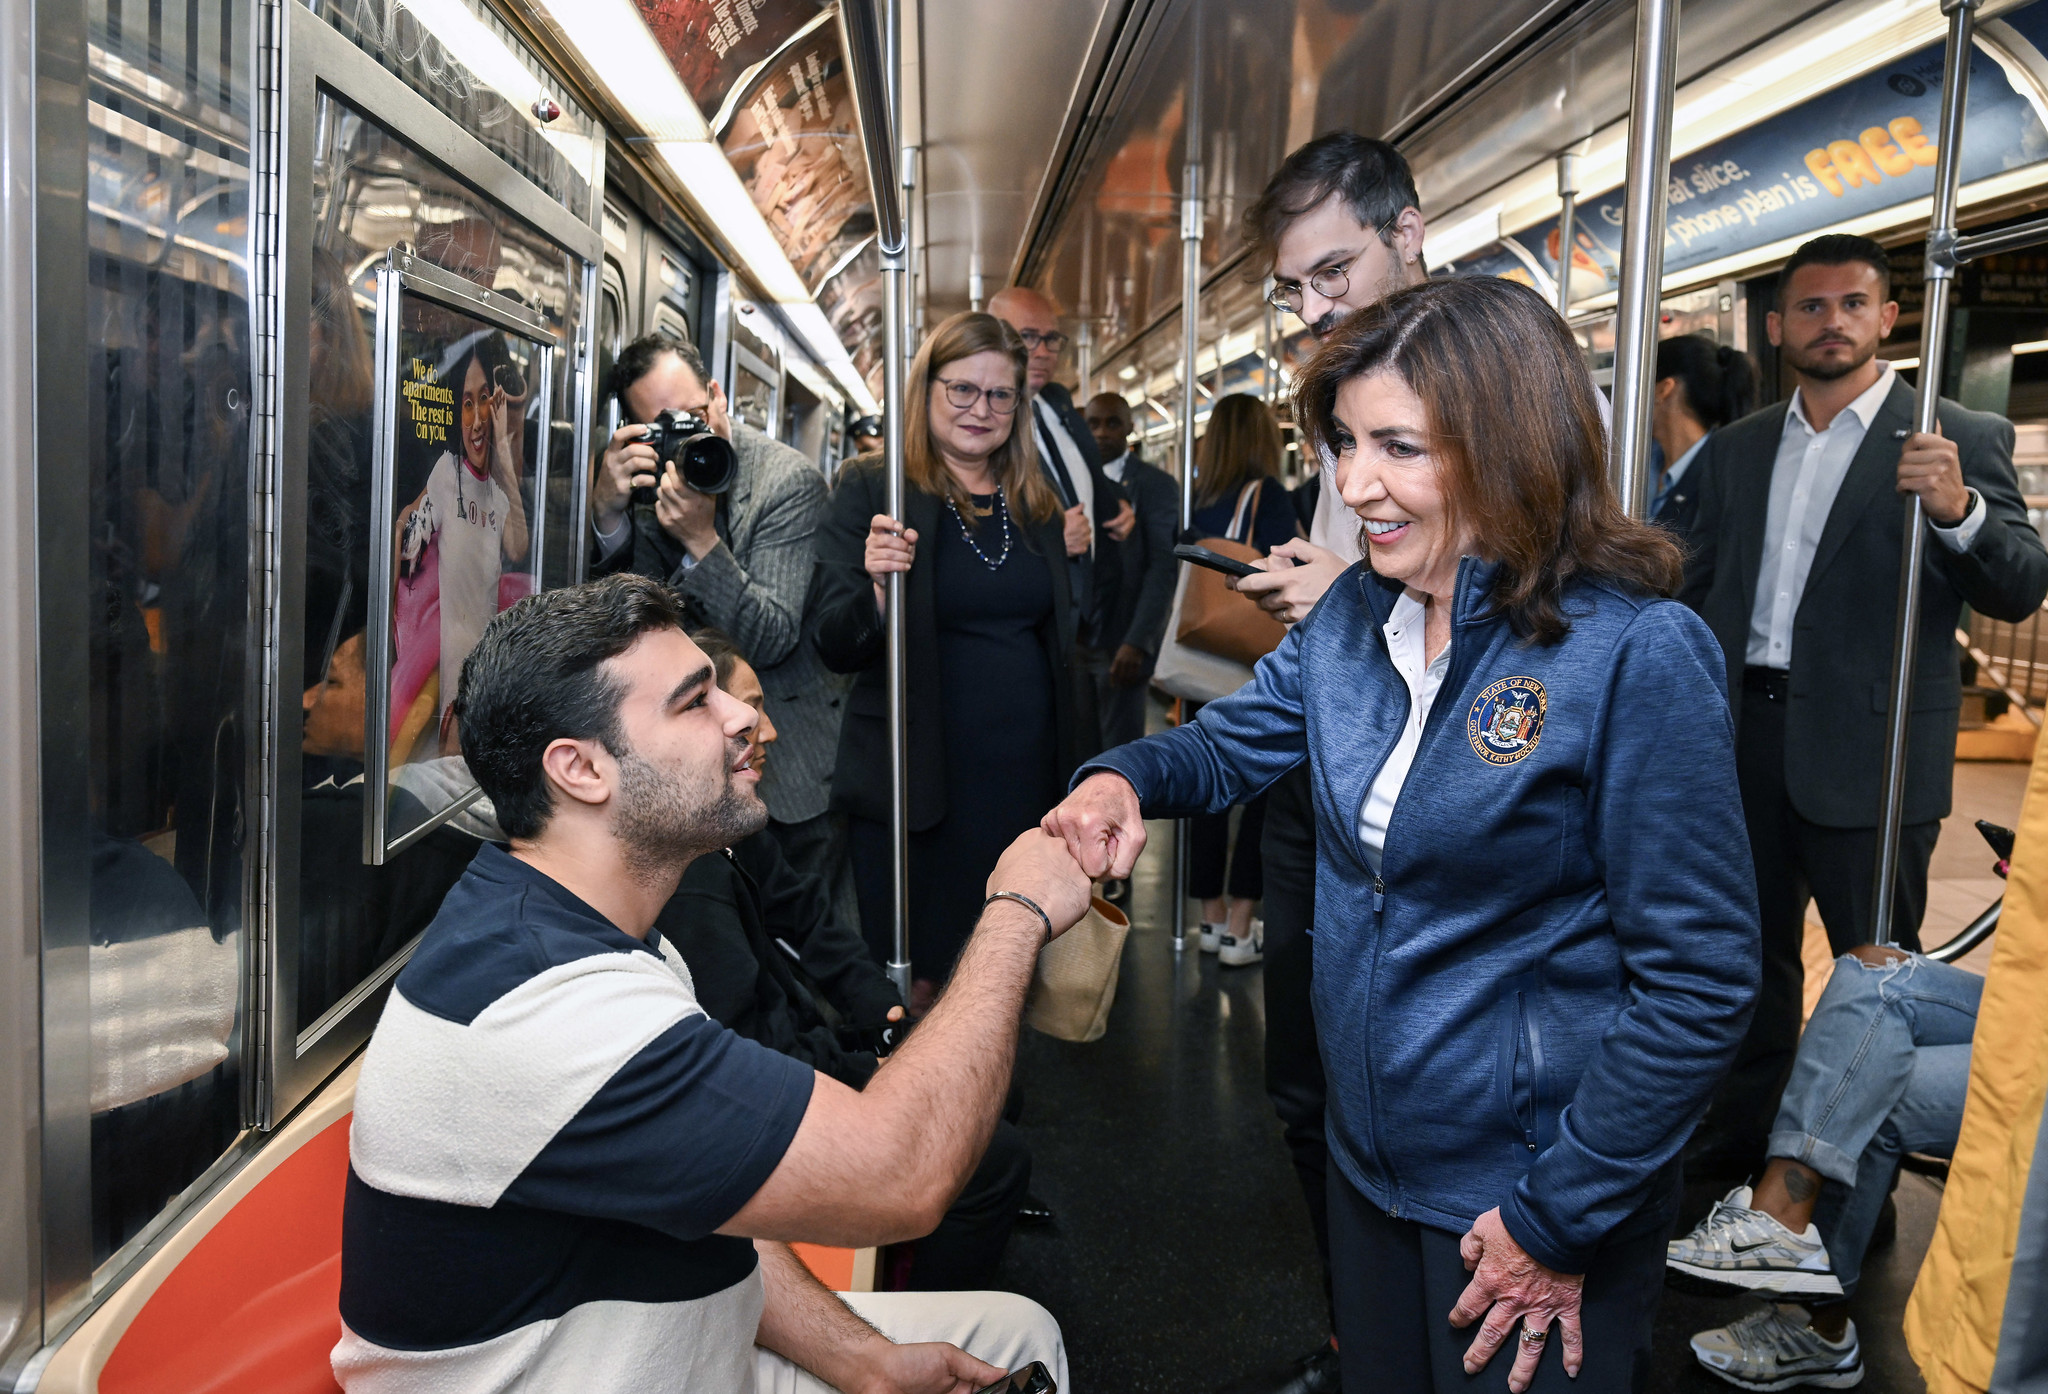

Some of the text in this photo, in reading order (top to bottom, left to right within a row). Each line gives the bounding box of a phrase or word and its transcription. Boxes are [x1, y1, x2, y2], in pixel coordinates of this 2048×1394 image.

[708, 23, 729, 60] on you.
[720, 16, 739, 40] rest
[728, 31, 743, 47] is
[1671, 205, 1743, 248] phone
[1737, 184, 1795, 226] plan
[1782, 172, 1819, 201] is
[1804, 116, 1939, 198] FREE
[1690, 160, 1751, 194] slice.
[412, 357, 439, 385] We do
[403, 379, 455, 405] apartments.
[411, 399, 453, 426] The rest is
[416, 422, 447, 445] on you.
[1481, 681, 1507, 701] STATE
[1510, 679, 1523, 687] OF
[1523, 680, 1541, 692] NEW
[1470, 719, 1489, 758] GOVERNOR
[1490, 754, 1514, 763] KATHY
